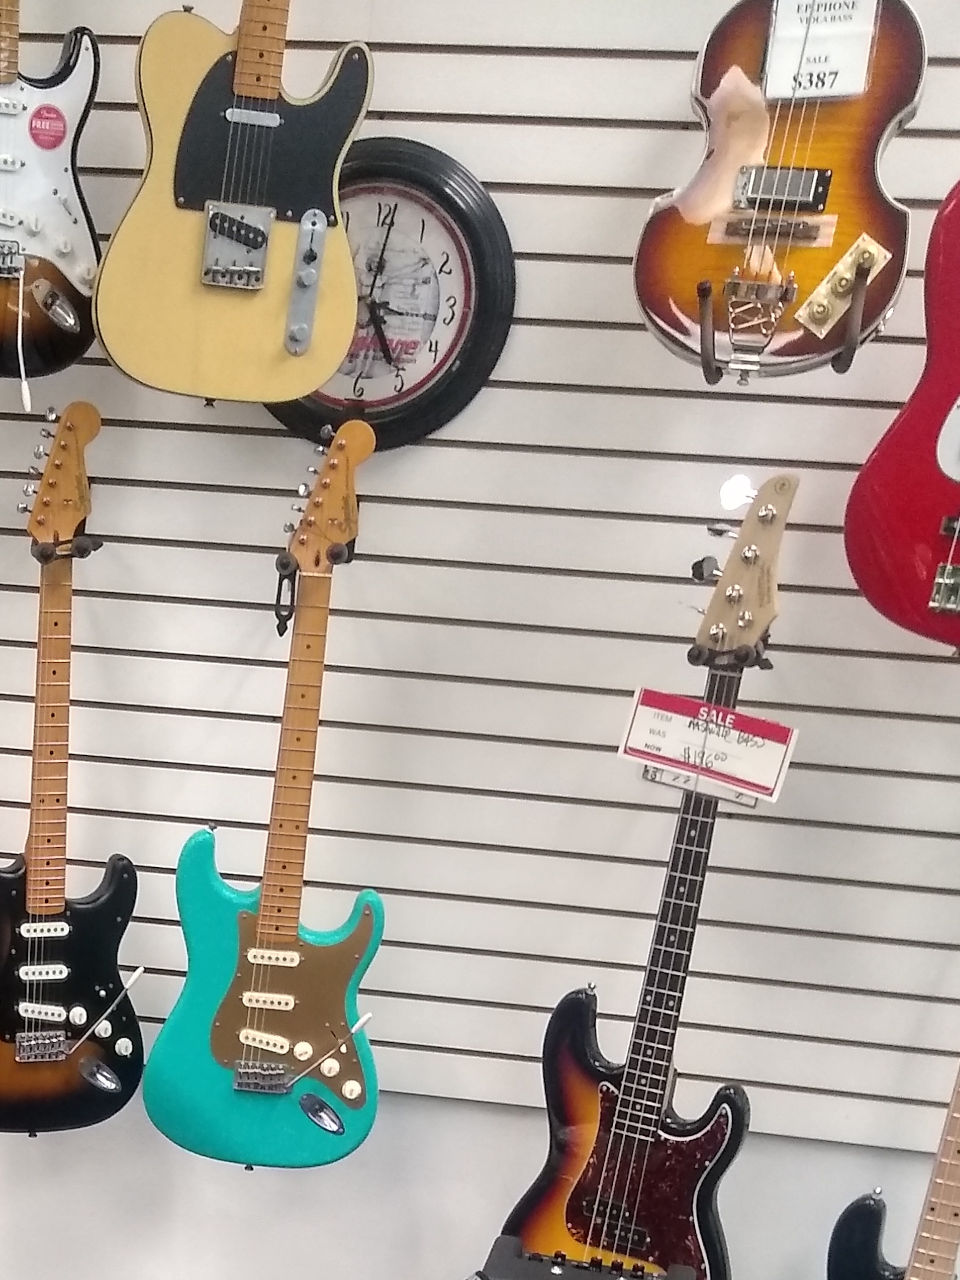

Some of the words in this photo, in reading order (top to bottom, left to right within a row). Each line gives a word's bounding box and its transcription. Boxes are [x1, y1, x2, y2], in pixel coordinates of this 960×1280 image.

[792, 70, 839, 90] $387
[439, 252, 453, 275] 2
[443, 296, 457, 325] 3
[430, 341, 439, 363] 4
[353, 371, 365, 398] 6
[698, 706, 736, 728] SALE
[648, 727, 666, 738] WAS
[644, 742, 662, 752] NOW
